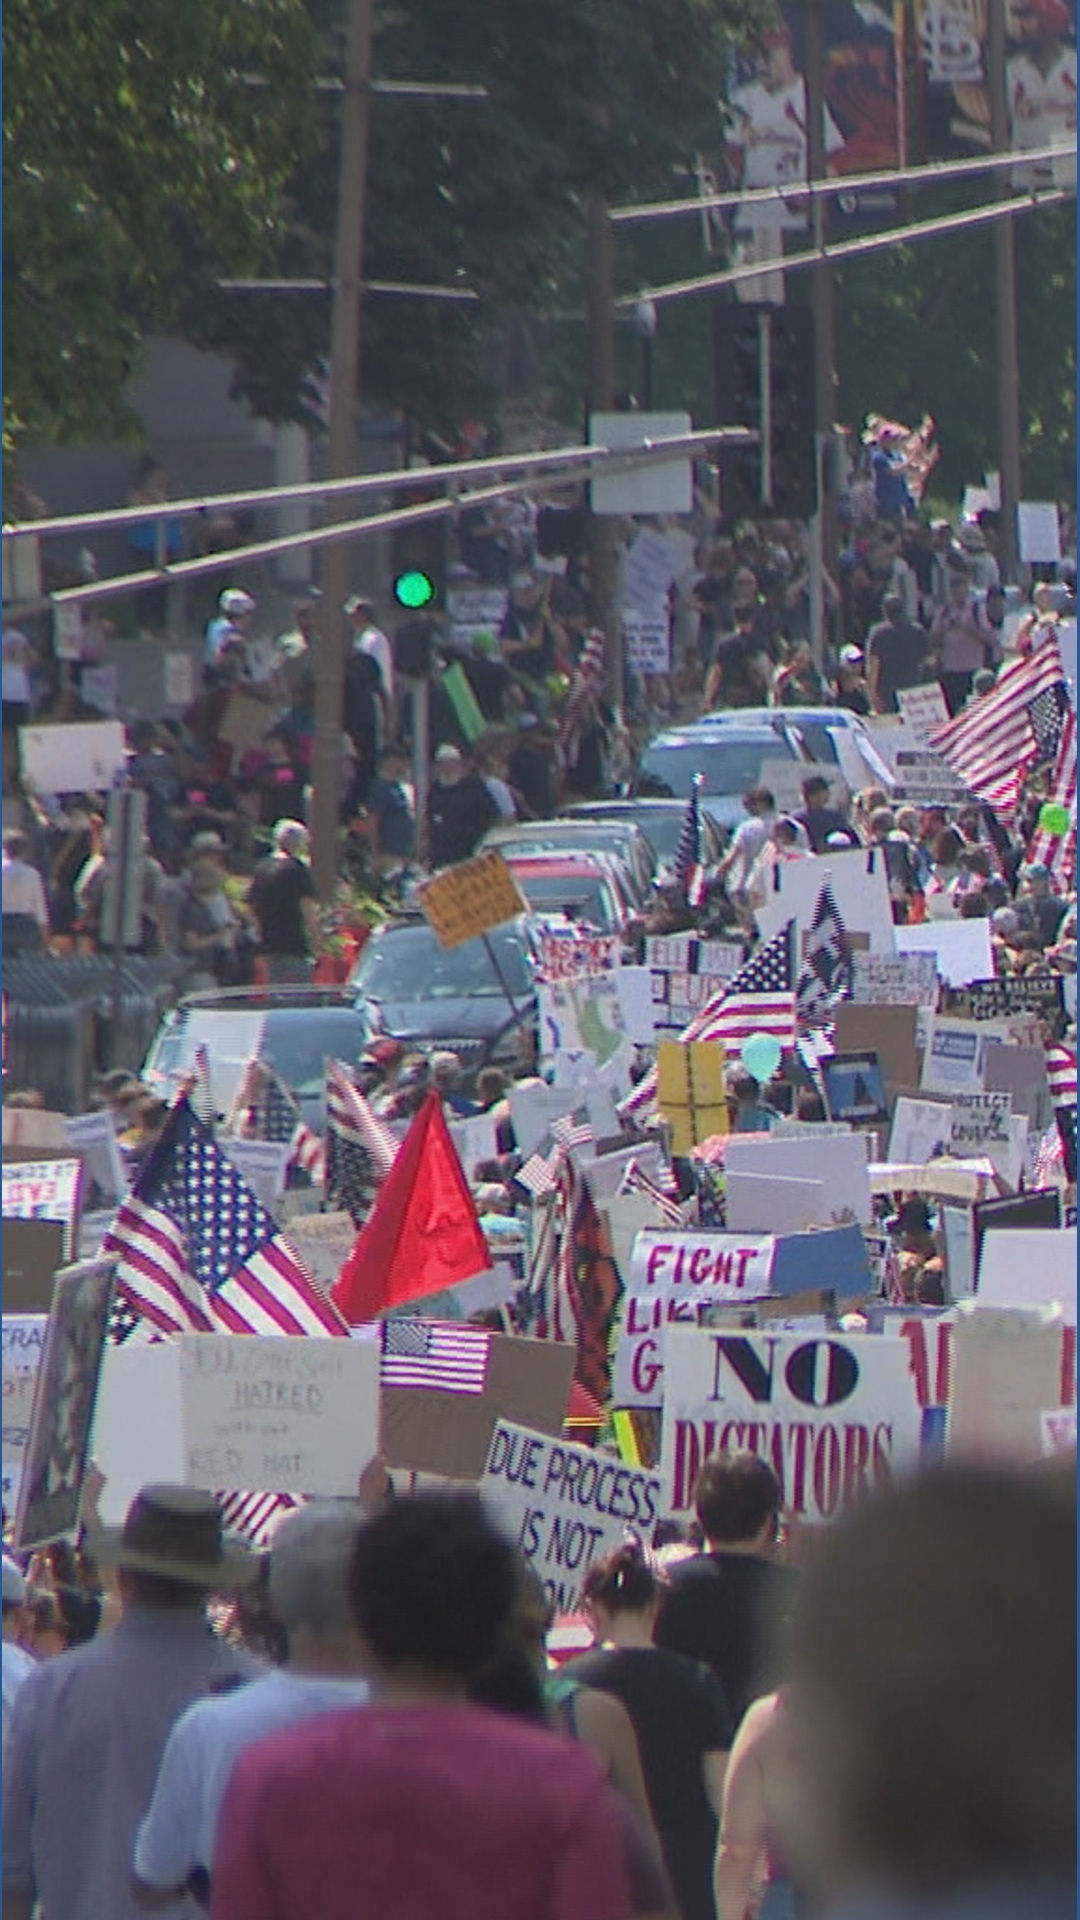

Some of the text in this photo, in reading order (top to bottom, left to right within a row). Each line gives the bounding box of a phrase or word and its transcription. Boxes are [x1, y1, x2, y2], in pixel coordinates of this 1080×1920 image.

[646, 1244, 759, 1288] FIGHT
[235, 1380, 324, 1410] HATRED
[705, 1335, 861, 1409] NO
[188, 1447, 302, 1476] RED HAT
[487, 1428, 661, 1527] DUE PROCESS
[670, 1419, 893, 1518] DATORS
[519, 1507, 604, 1569] IS NOT
